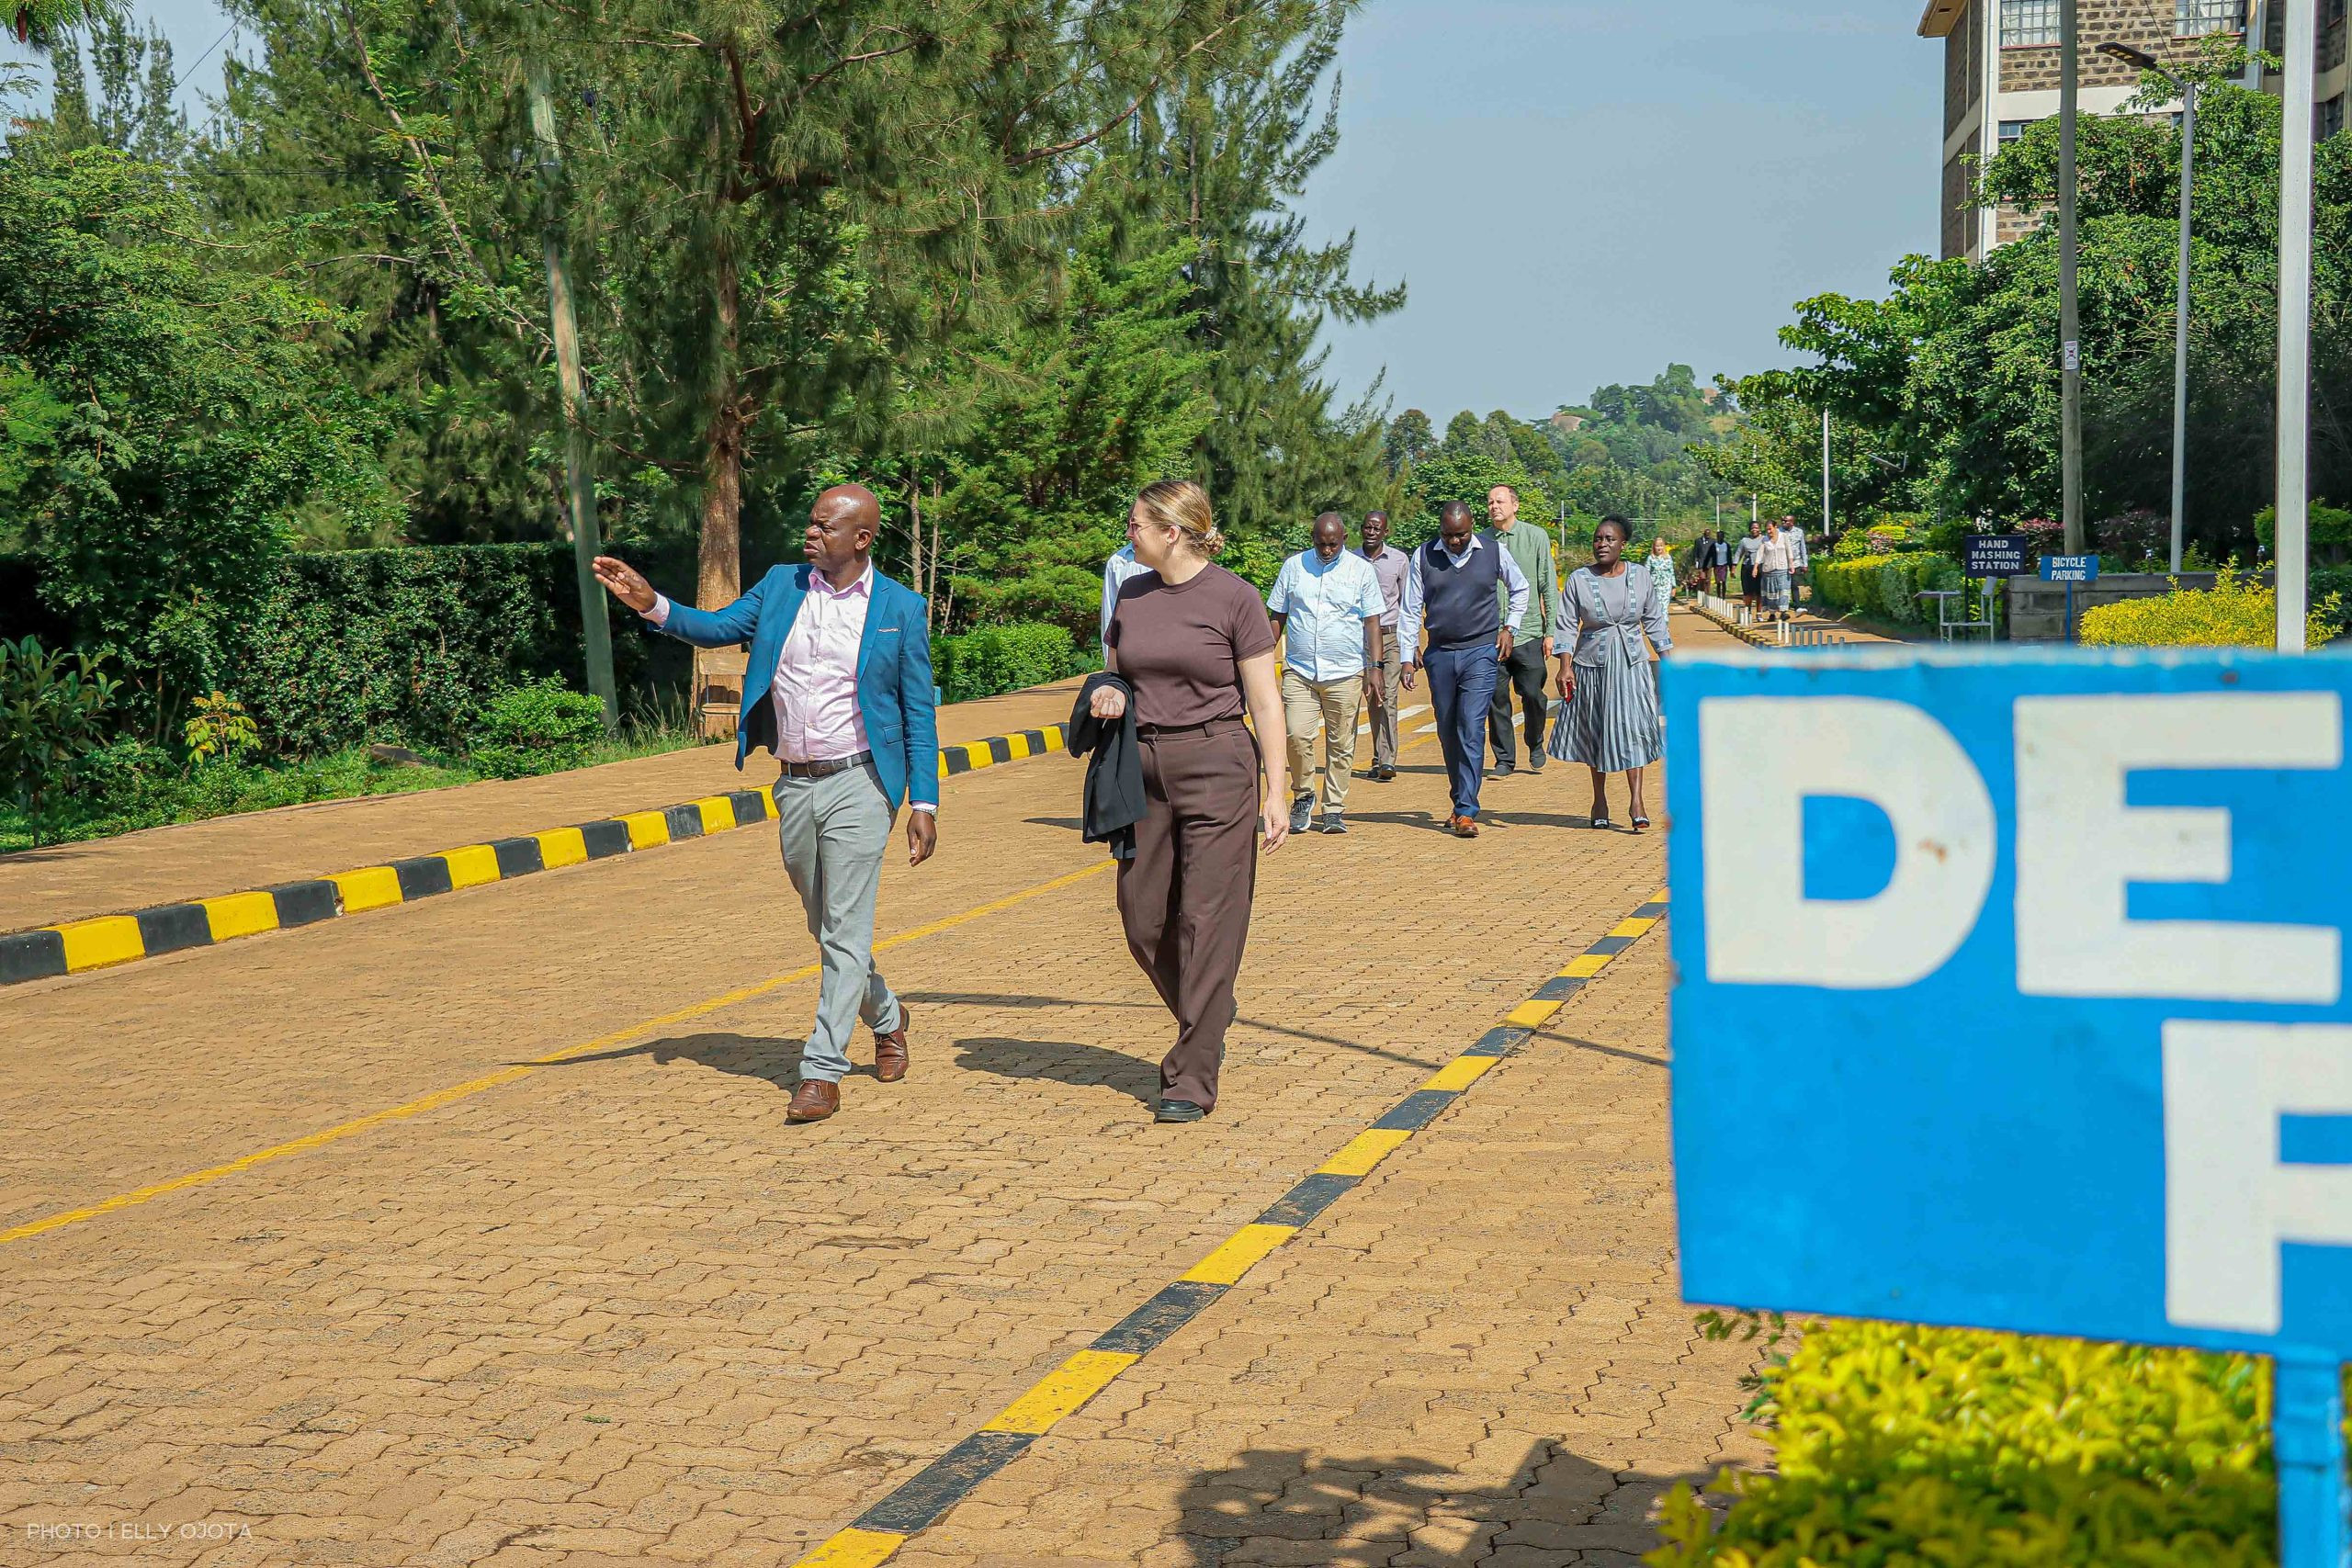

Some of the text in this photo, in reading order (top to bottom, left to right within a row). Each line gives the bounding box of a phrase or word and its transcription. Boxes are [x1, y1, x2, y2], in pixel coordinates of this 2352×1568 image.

[1978, 539, 2008, 548] HAND
[1971, 561, 2019, 570] STATION
[2052, 557, 2086, 568] BICYCLE
[2051, 570, 2086, 581] PARKING
[1698, 691, 2343, 1005] DE
